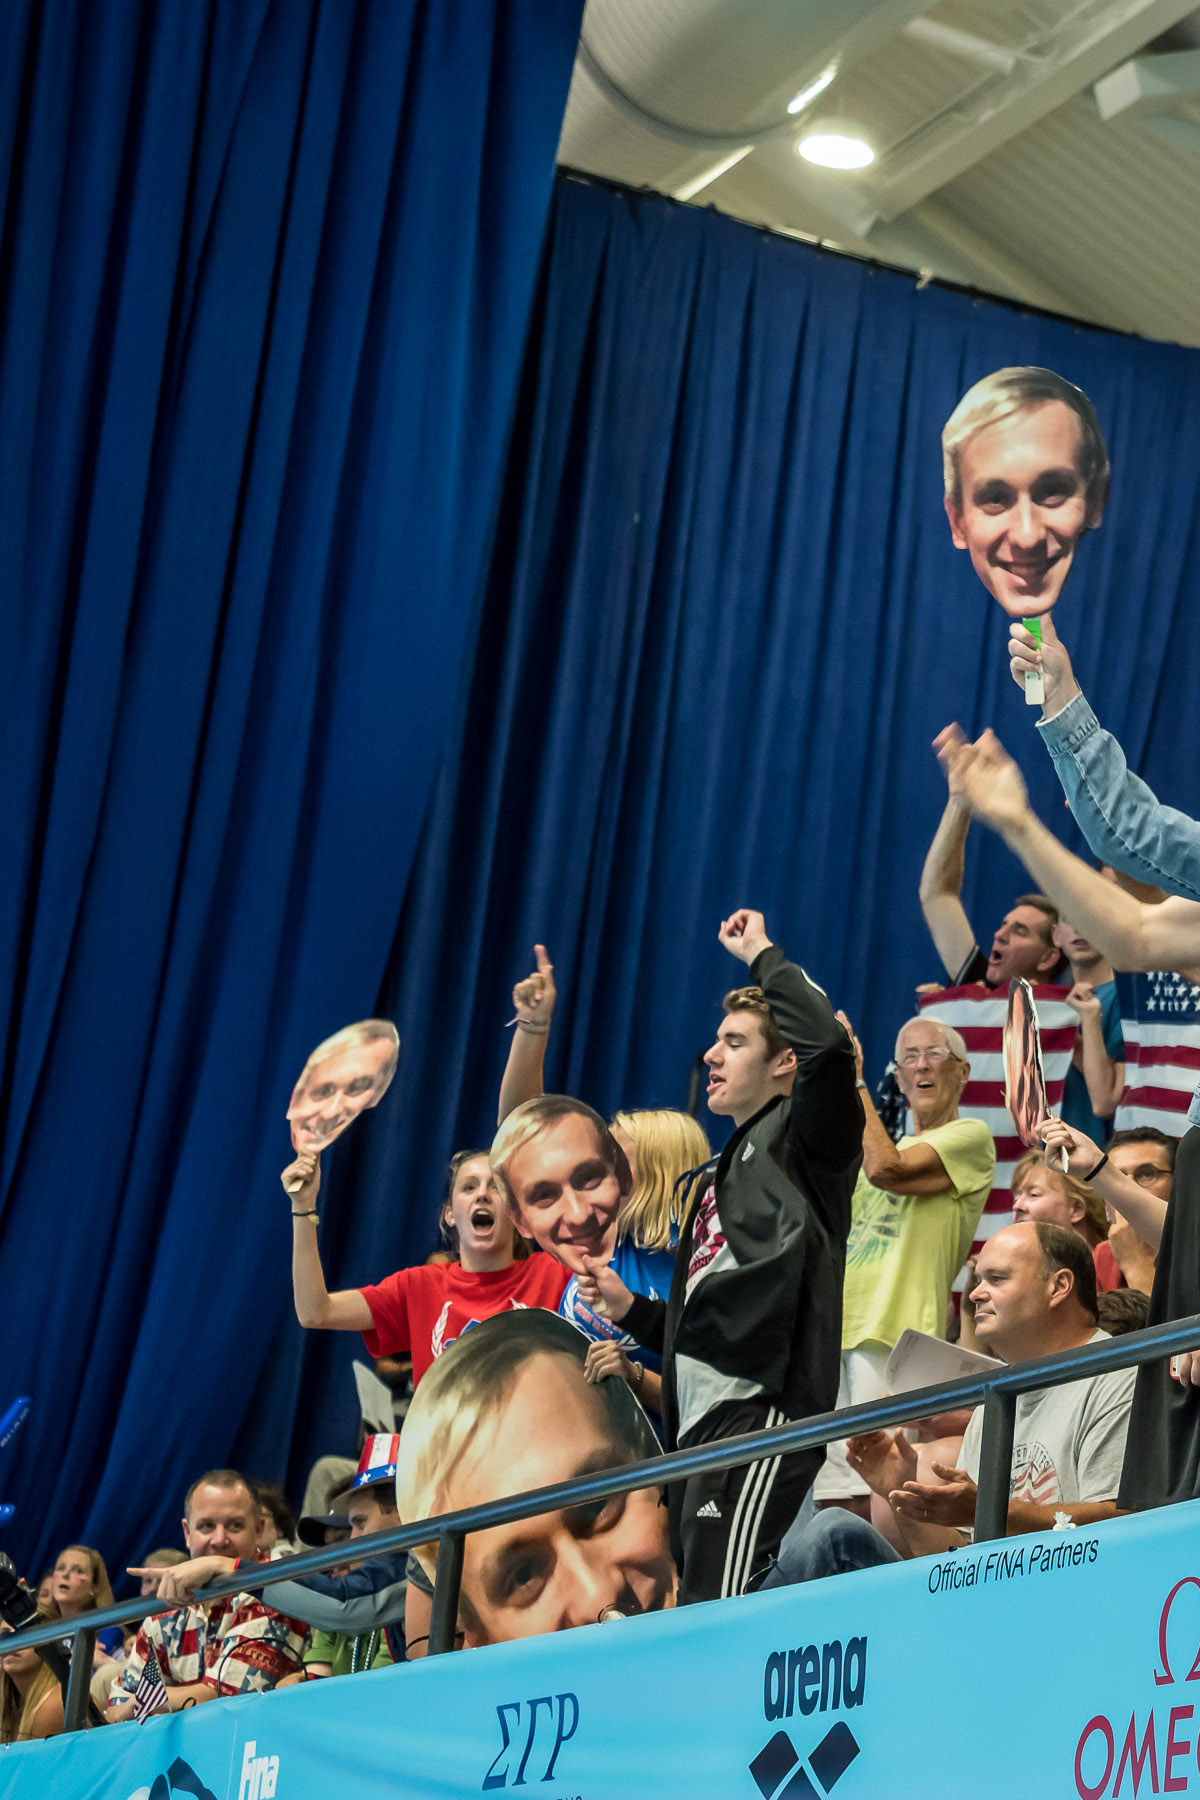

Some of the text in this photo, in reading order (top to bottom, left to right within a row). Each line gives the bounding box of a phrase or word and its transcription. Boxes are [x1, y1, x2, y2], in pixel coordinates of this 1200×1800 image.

[928, 1539, 1099, 1594] Official FINA Partners
[764, 1636, 868, 1722] arena
